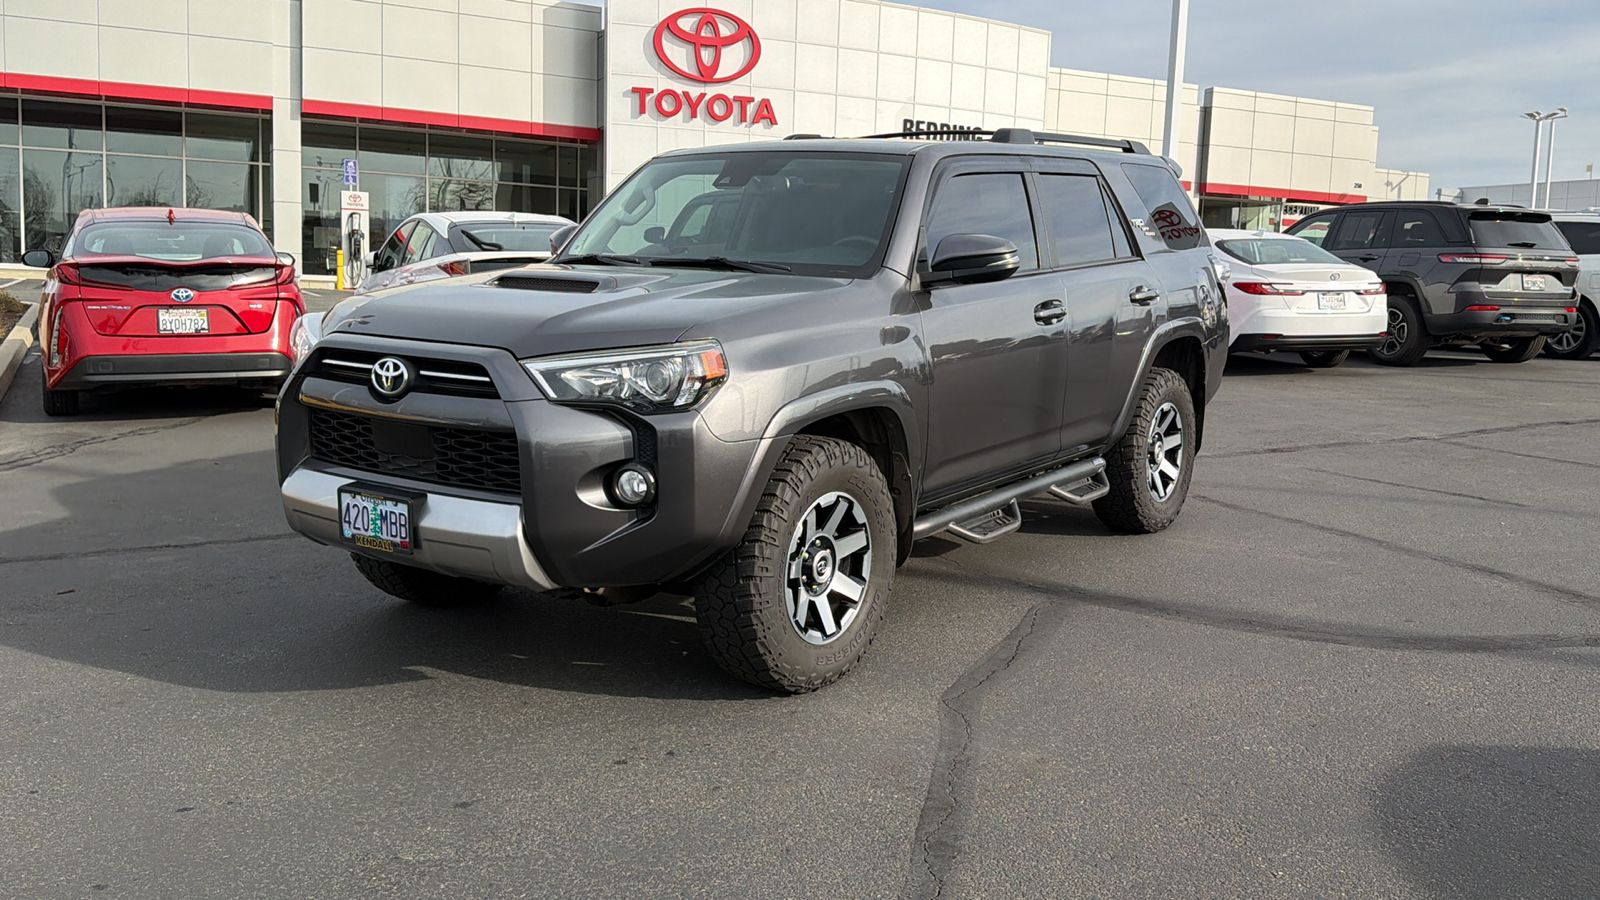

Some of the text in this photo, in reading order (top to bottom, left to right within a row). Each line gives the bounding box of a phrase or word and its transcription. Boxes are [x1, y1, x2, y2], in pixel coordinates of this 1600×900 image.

[631, 86, 779, 126] TOYOTA
[1325, 296, 1343, 304] LITHIA
[343, 502, 408, 540] 420 MBB
[356, 535, 393, 551] KENDALL
[816, 589, 882, 667] DISCOVERER
